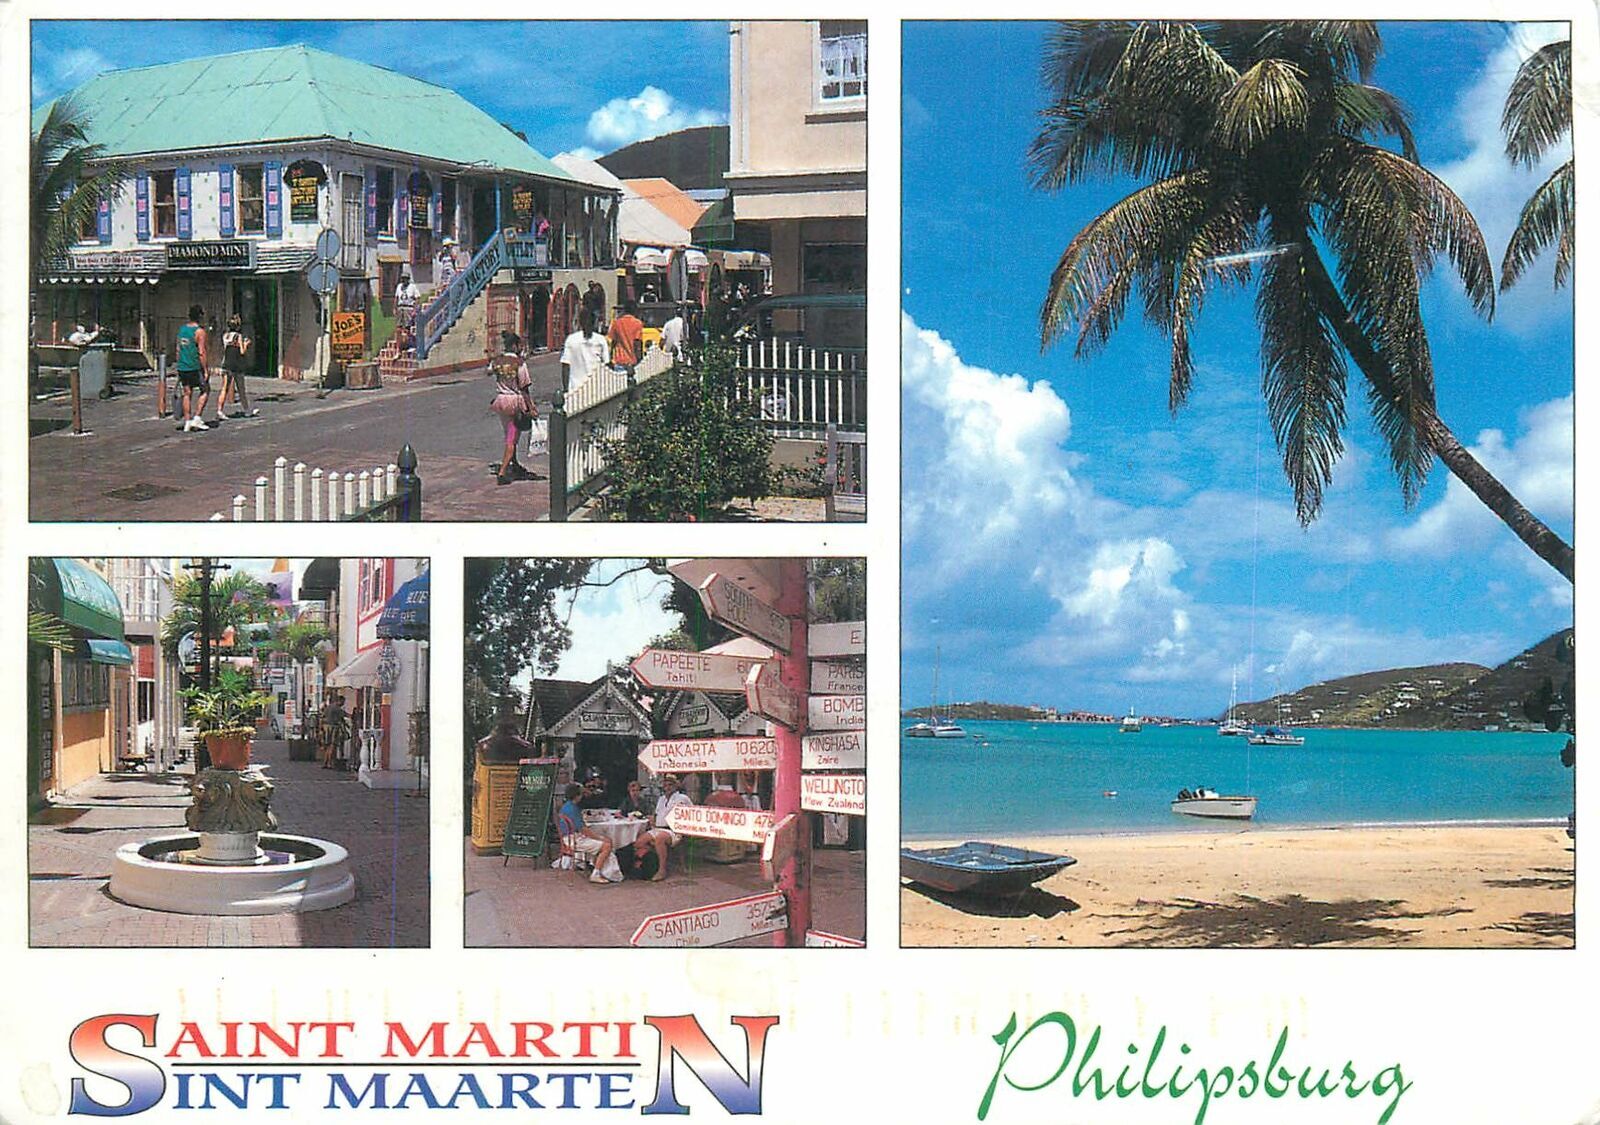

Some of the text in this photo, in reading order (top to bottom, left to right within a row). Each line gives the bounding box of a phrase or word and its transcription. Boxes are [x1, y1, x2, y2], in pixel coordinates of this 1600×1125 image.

[653, 653, 711, 671] PAPEETE
[666, 671, 697, 683] Tahiti
[828, 665, 864, 679] PARIS
[828, 683, 864, 692] France
[823, 698, 864, 713] BOMB
[836, 715, 864, 725] India
[652, 743, 717, 758] DJAKARTA
[808, 735, 860, 752] KINSHASA
[658, 760, 707, 768] Indonesia
[818, 754, 839, 765] Zaire
[804, 778, 865, 795] WELLINGTO
[674, 807, 701, 821] SANTO
[705, 810, 746, 826] DOMINGO
[654, 911, 720, 939] SANTIAGO
